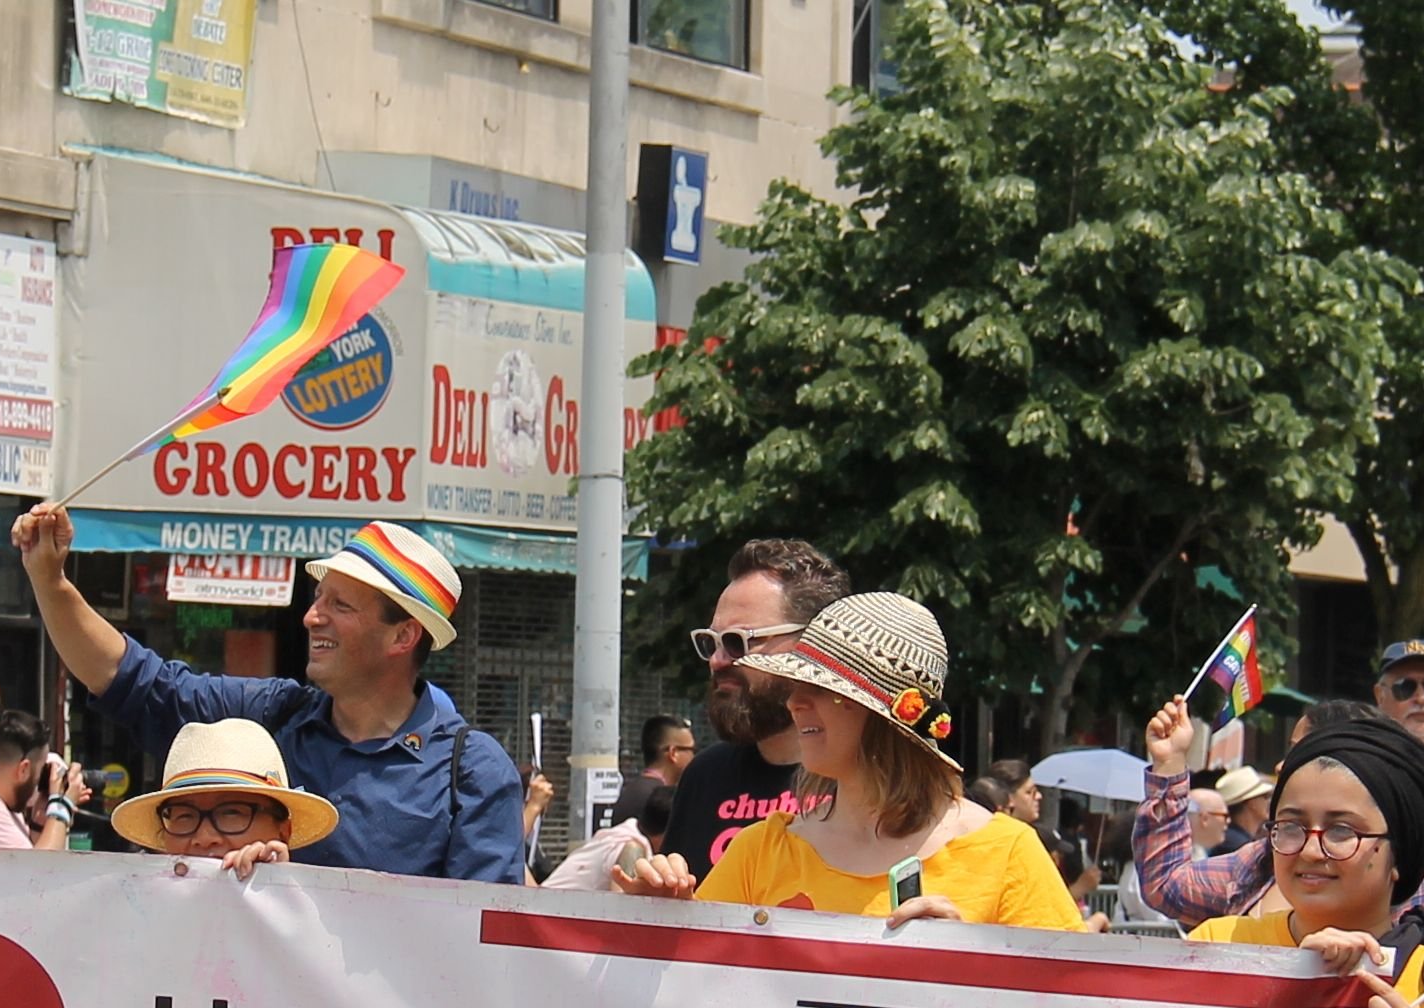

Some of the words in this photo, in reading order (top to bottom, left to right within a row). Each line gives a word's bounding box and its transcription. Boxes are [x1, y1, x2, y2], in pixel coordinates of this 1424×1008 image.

[331, 329, 376, 362] YORK
[292, 352, 384, 414] LOTTERY
[430, 365, 489, 469] DELI
[153, 441, 417, 502] GROCERY
[161, 523, 253, 551] MONEY
[260, 525, 355, 556] TRANSF
